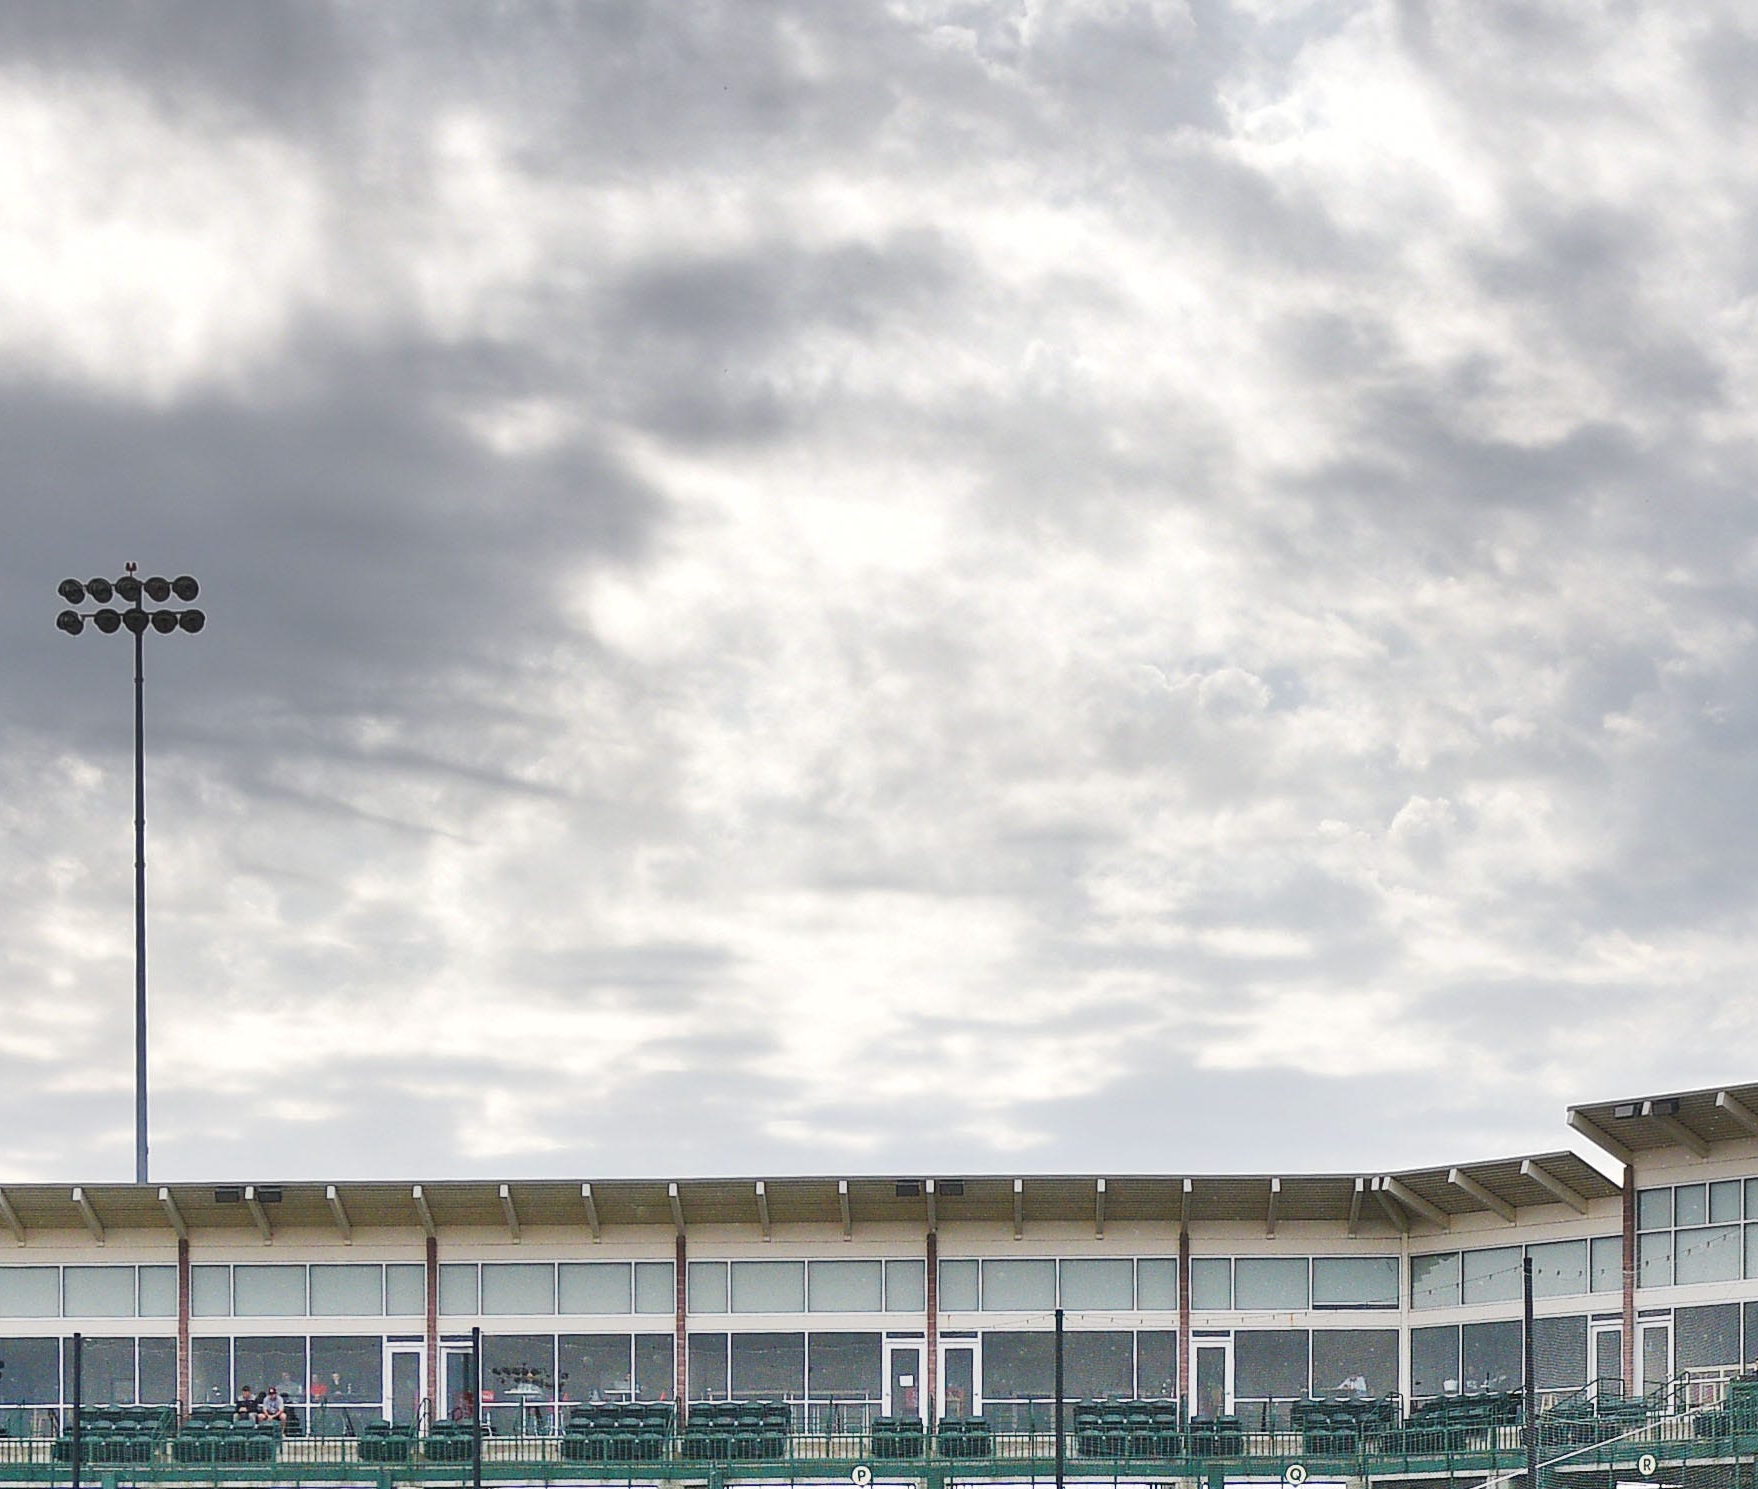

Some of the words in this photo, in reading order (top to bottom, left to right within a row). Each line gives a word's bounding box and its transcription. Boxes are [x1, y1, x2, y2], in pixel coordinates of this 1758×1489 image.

[1643, 1458, 1651, 1471] R
[857, 1469, 866, 1482] P
[1290, 1468, 1301, 1481] Q
